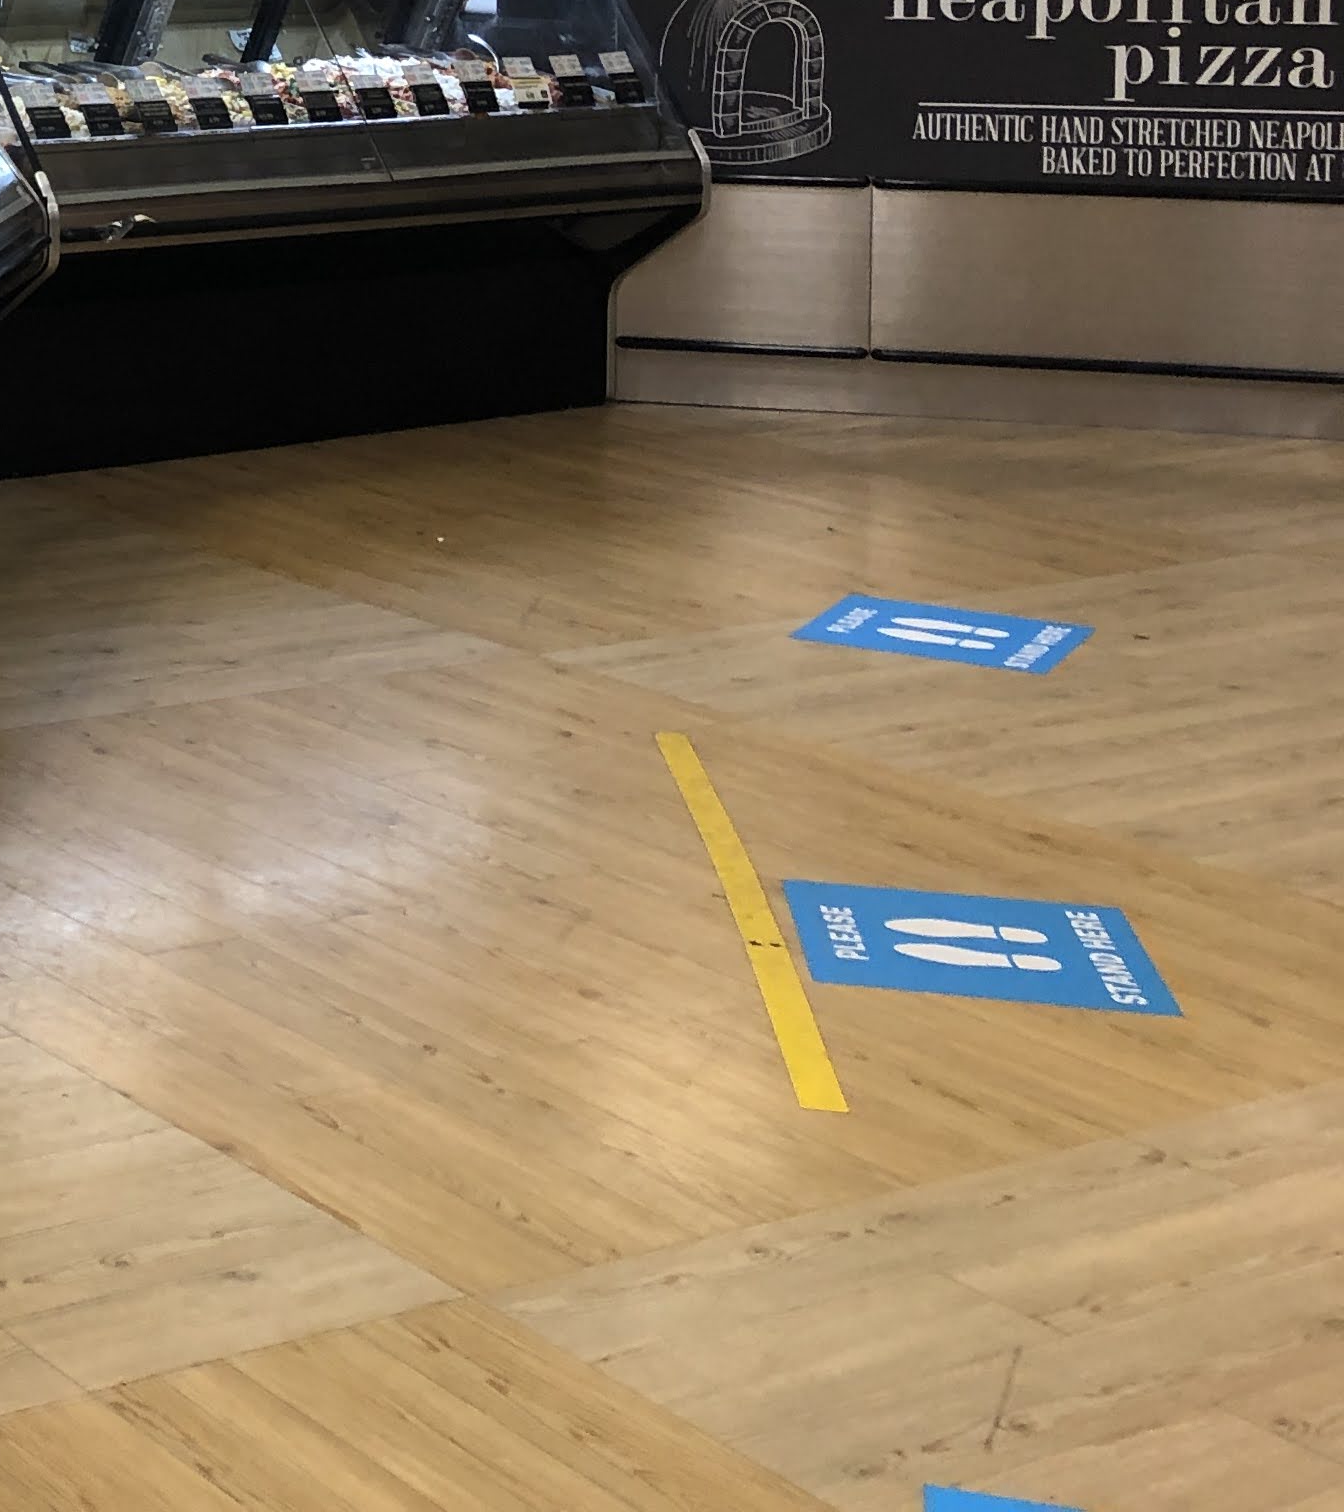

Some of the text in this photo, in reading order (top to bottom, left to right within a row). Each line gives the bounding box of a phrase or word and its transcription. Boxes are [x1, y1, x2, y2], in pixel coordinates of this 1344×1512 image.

[1105, 26, 1335, 102] pizza
[912, 113, 1035, 144] AUTHENTIC
[1042, 115, 1103, 146] HAND
[1111, 116, 1241, 149] STRETCHED
[1041, 146, 1336, 182] BAKED TO PERFECTION AT
[819, 903, 870, 960] PLEASE
[1065, 910, 1150, 1006] STAND HERE
